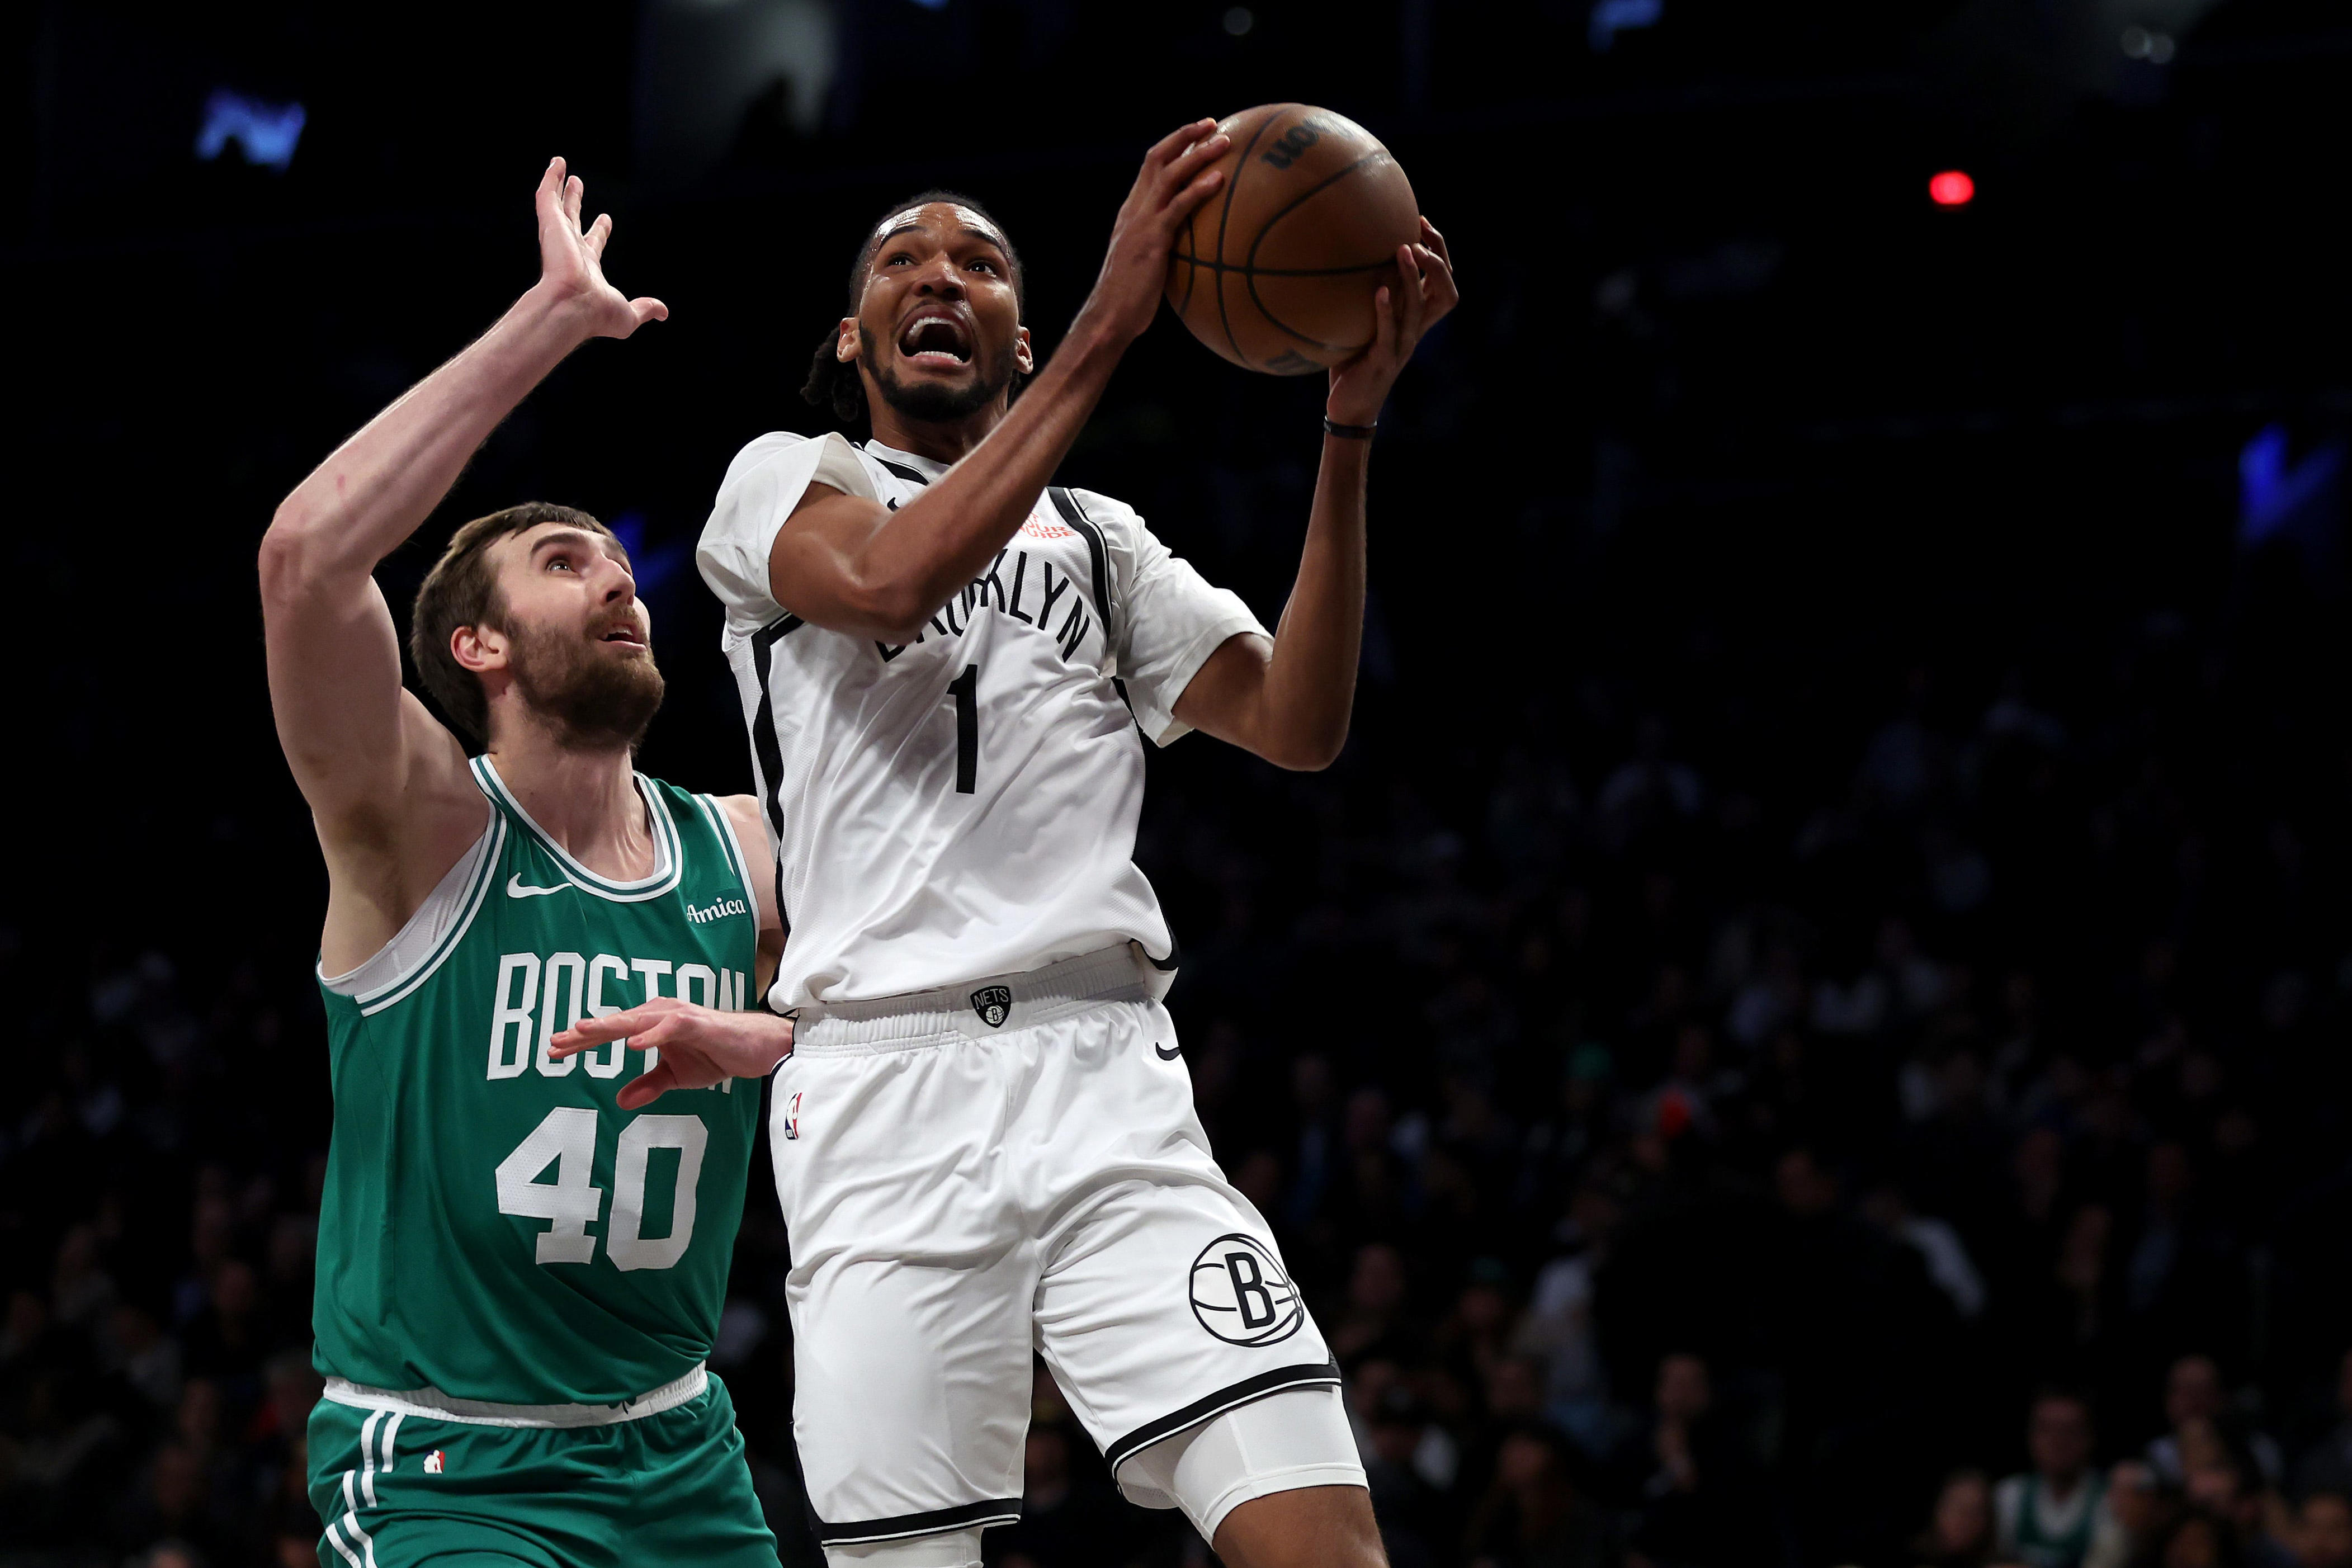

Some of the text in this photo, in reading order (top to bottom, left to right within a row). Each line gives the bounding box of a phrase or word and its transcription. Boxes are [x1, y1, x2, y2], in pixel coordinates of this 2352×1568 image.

[1024, 517, 1067, 532] OUR
[947, 664, 978, 795] 1
[687, 897, 747, 924] Amica
[974, 988, 1009, 1010] NETS
[991, 1008, 999, 1022] B
[495, 1106, 709, 1272] 40
[1224, 1251, 1276, 1330] B
